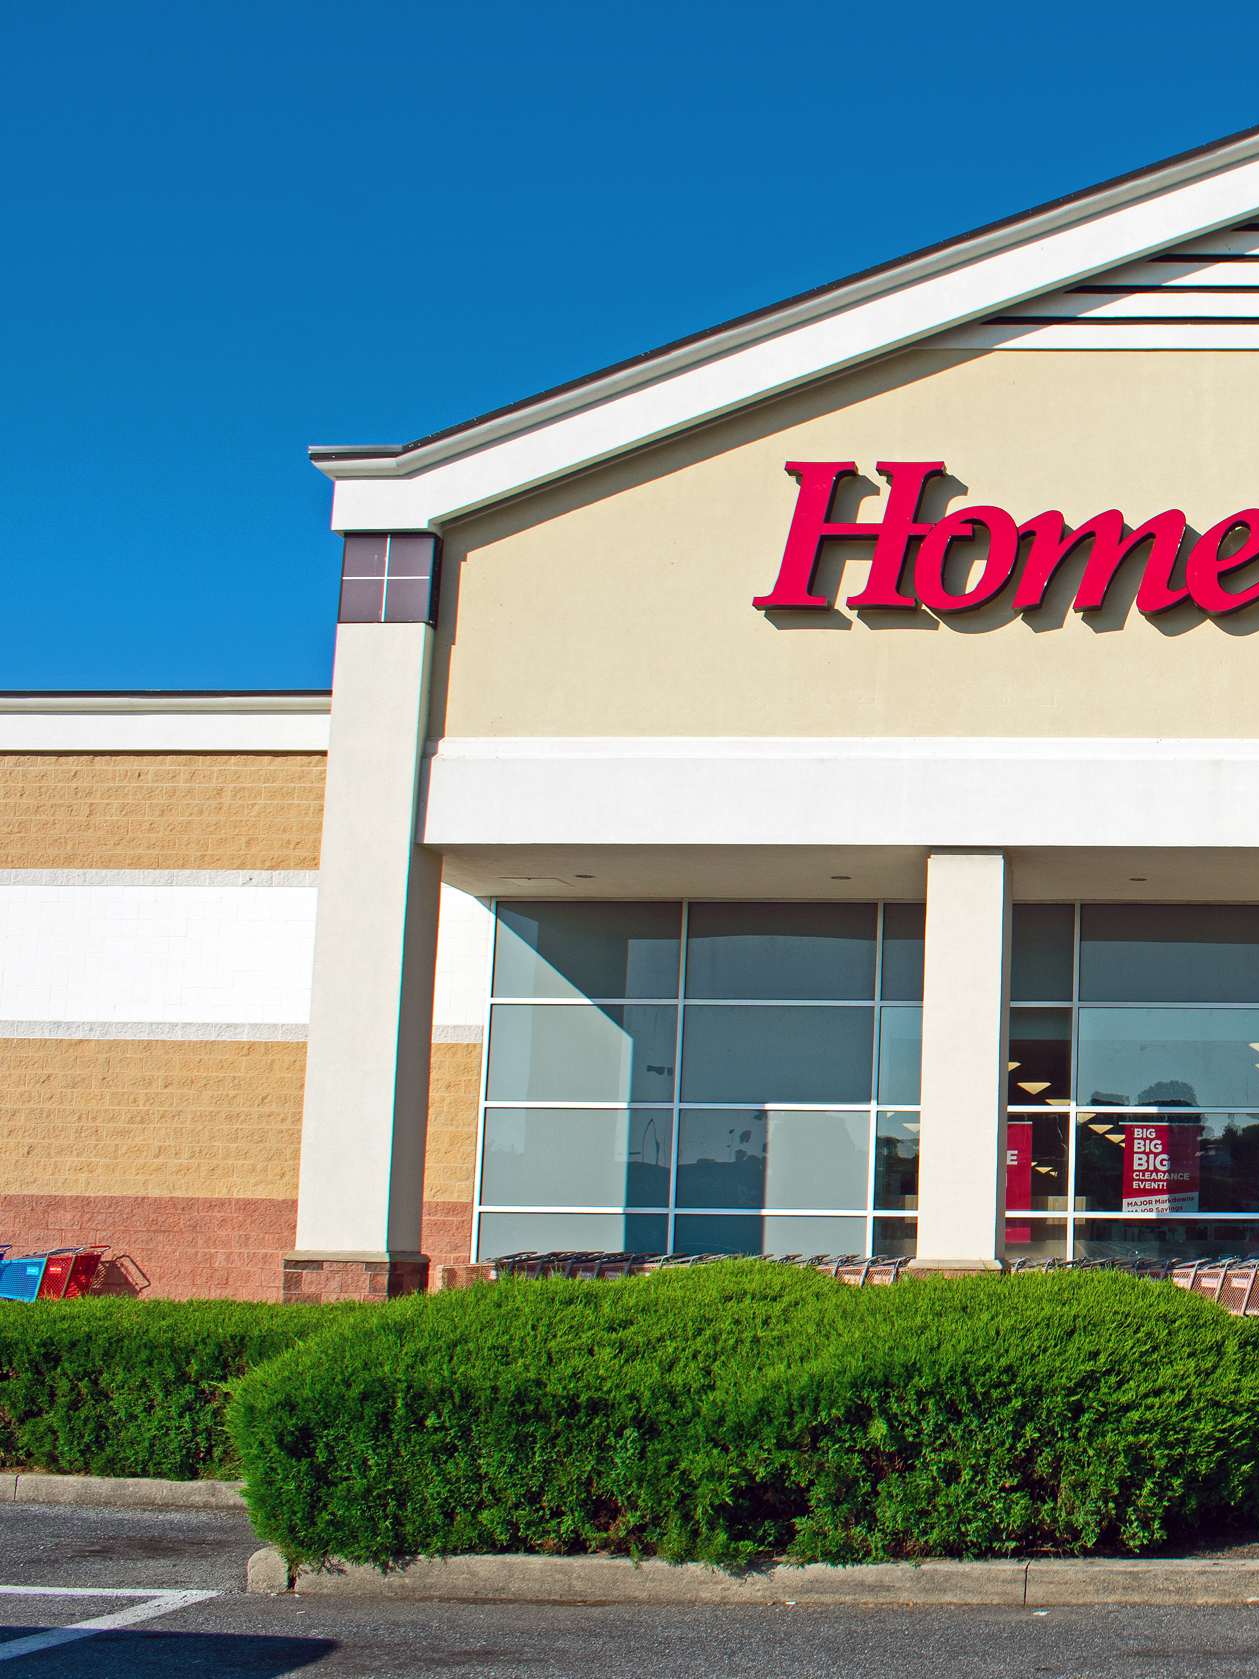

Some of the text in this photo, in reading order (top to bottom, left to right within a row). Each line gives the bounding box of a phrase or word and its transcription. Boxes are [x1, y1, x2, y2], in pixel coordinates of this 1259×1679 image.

[1134, 1128, 1156, 1138] BIG
[1133, 1139, 1163, 1152] BIG
[1133, 1154, 1171, 1170] BIG
[1133, 1172, 1190, 1180] CLEARANCE
[1132, 1181, 1167, 1189] EVENT!
[1127, 1199, 1153, 1208] MAJOR
